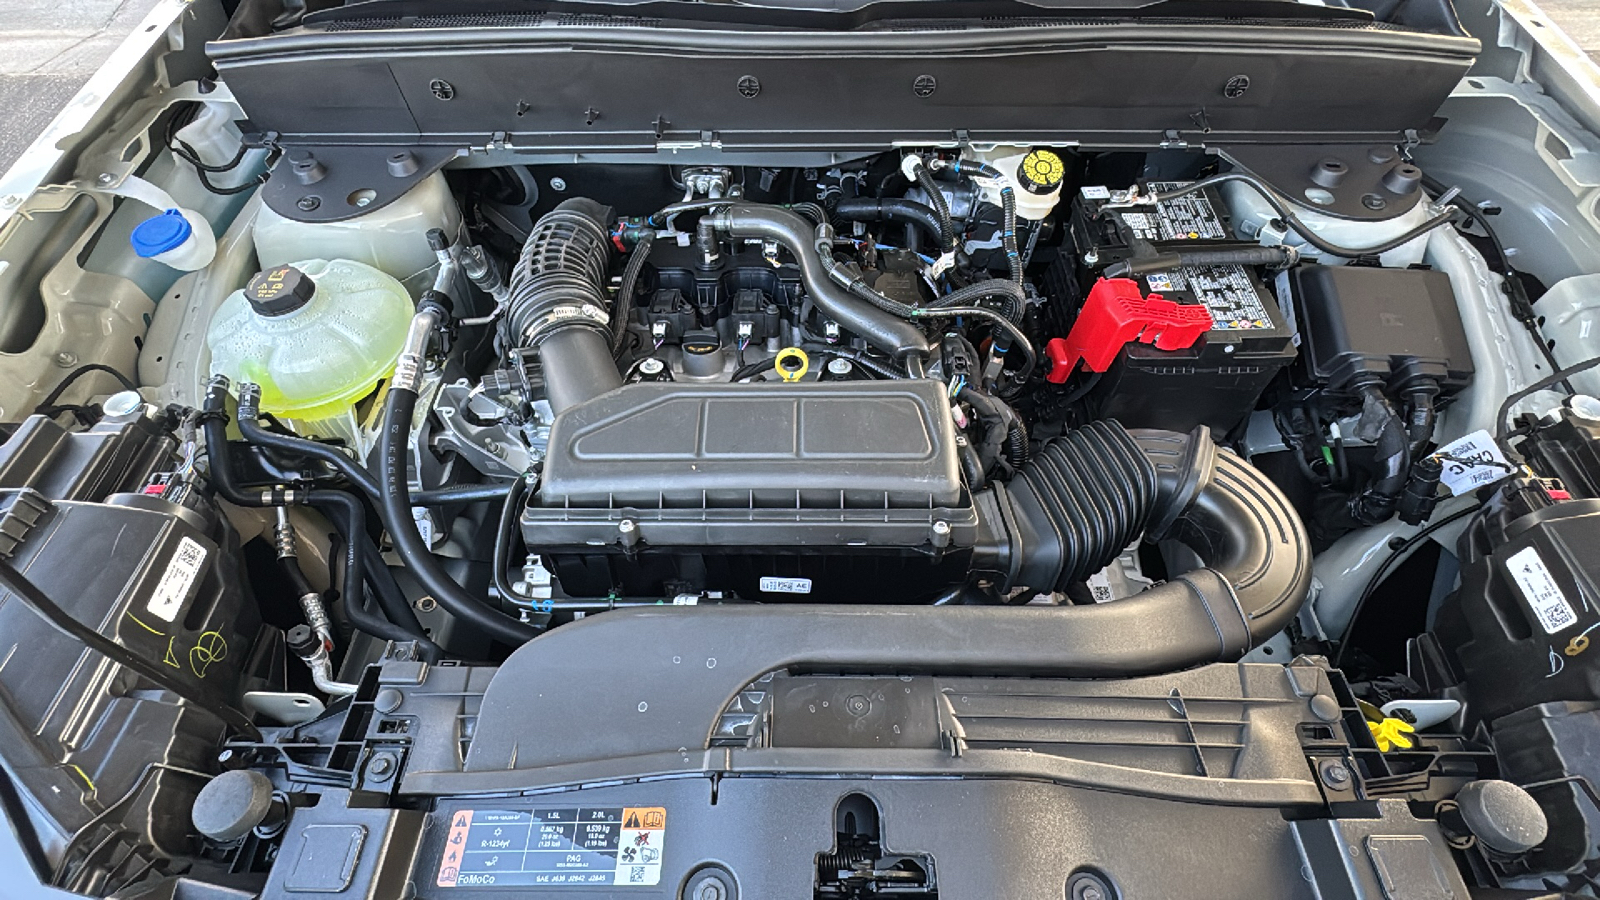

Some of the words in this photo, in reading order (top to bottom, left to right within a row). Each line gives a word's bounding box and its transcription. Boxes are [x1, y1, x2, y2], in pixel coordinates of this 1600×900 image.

[591, 811, 605, 819] 2.0L
[556, 825, 564, 834] kg
[602, 825, 611, 834] kg
[481, 840, 511, 849] R-1234yf
[566, 854, 581, 862] PAG
[458, 875, 496, 884] FoMoCo
